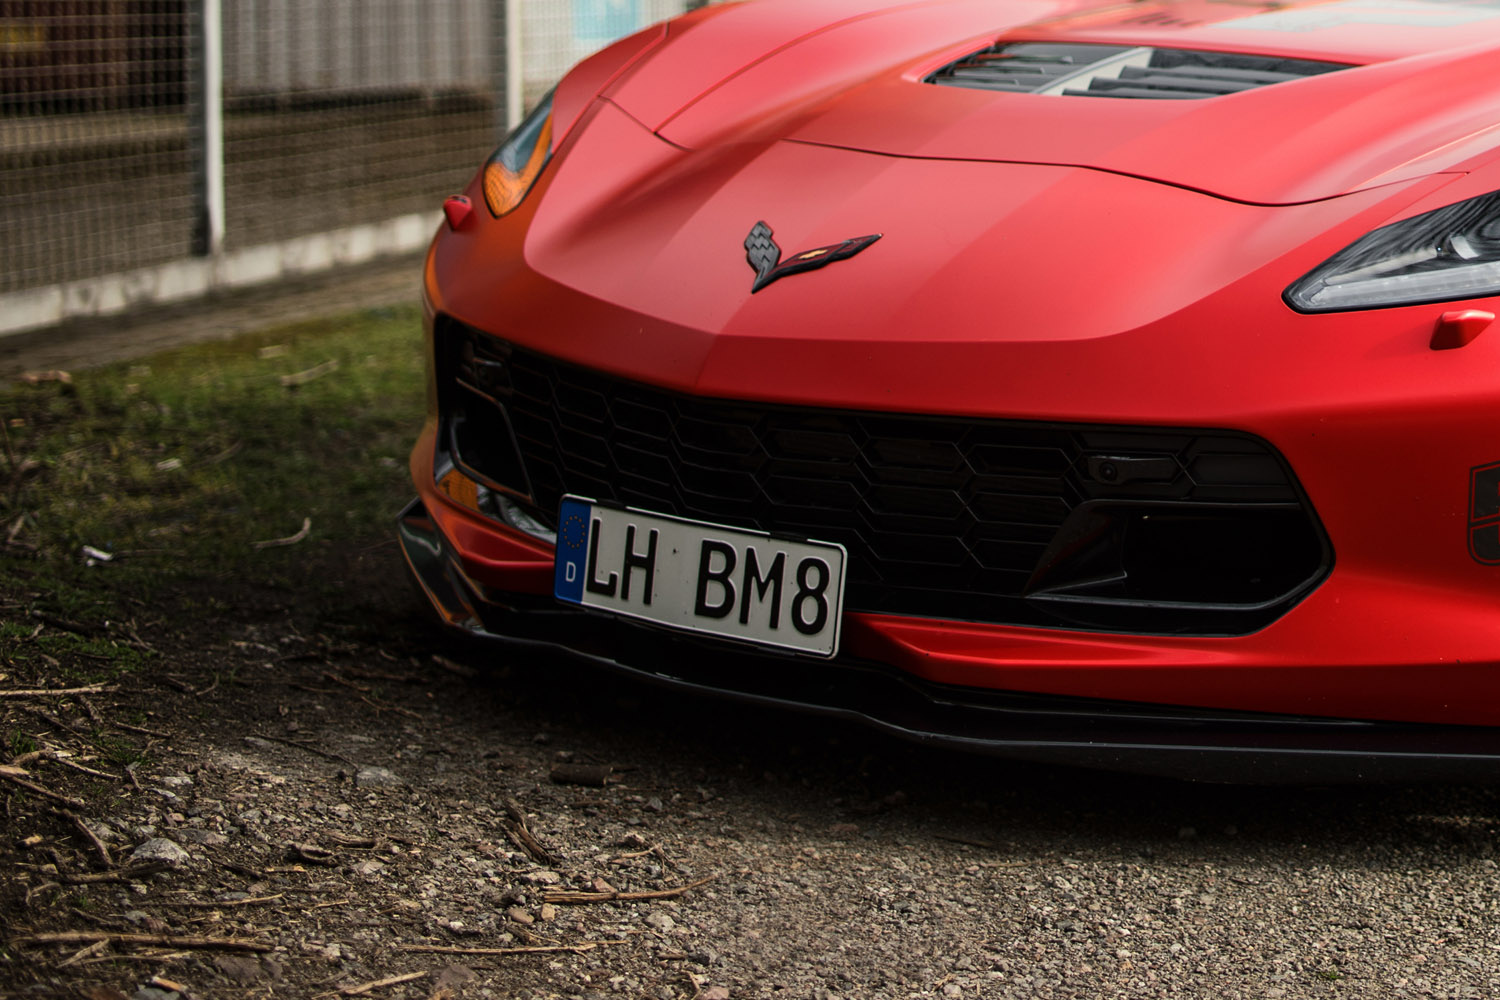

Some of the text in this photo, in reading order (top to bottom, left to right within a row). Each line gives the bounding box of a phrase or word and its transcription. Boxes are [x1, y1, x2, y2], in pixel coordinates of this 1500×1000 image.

[565, 562, 576, 582] D
[586, 518, 830, 635] LH BM8
